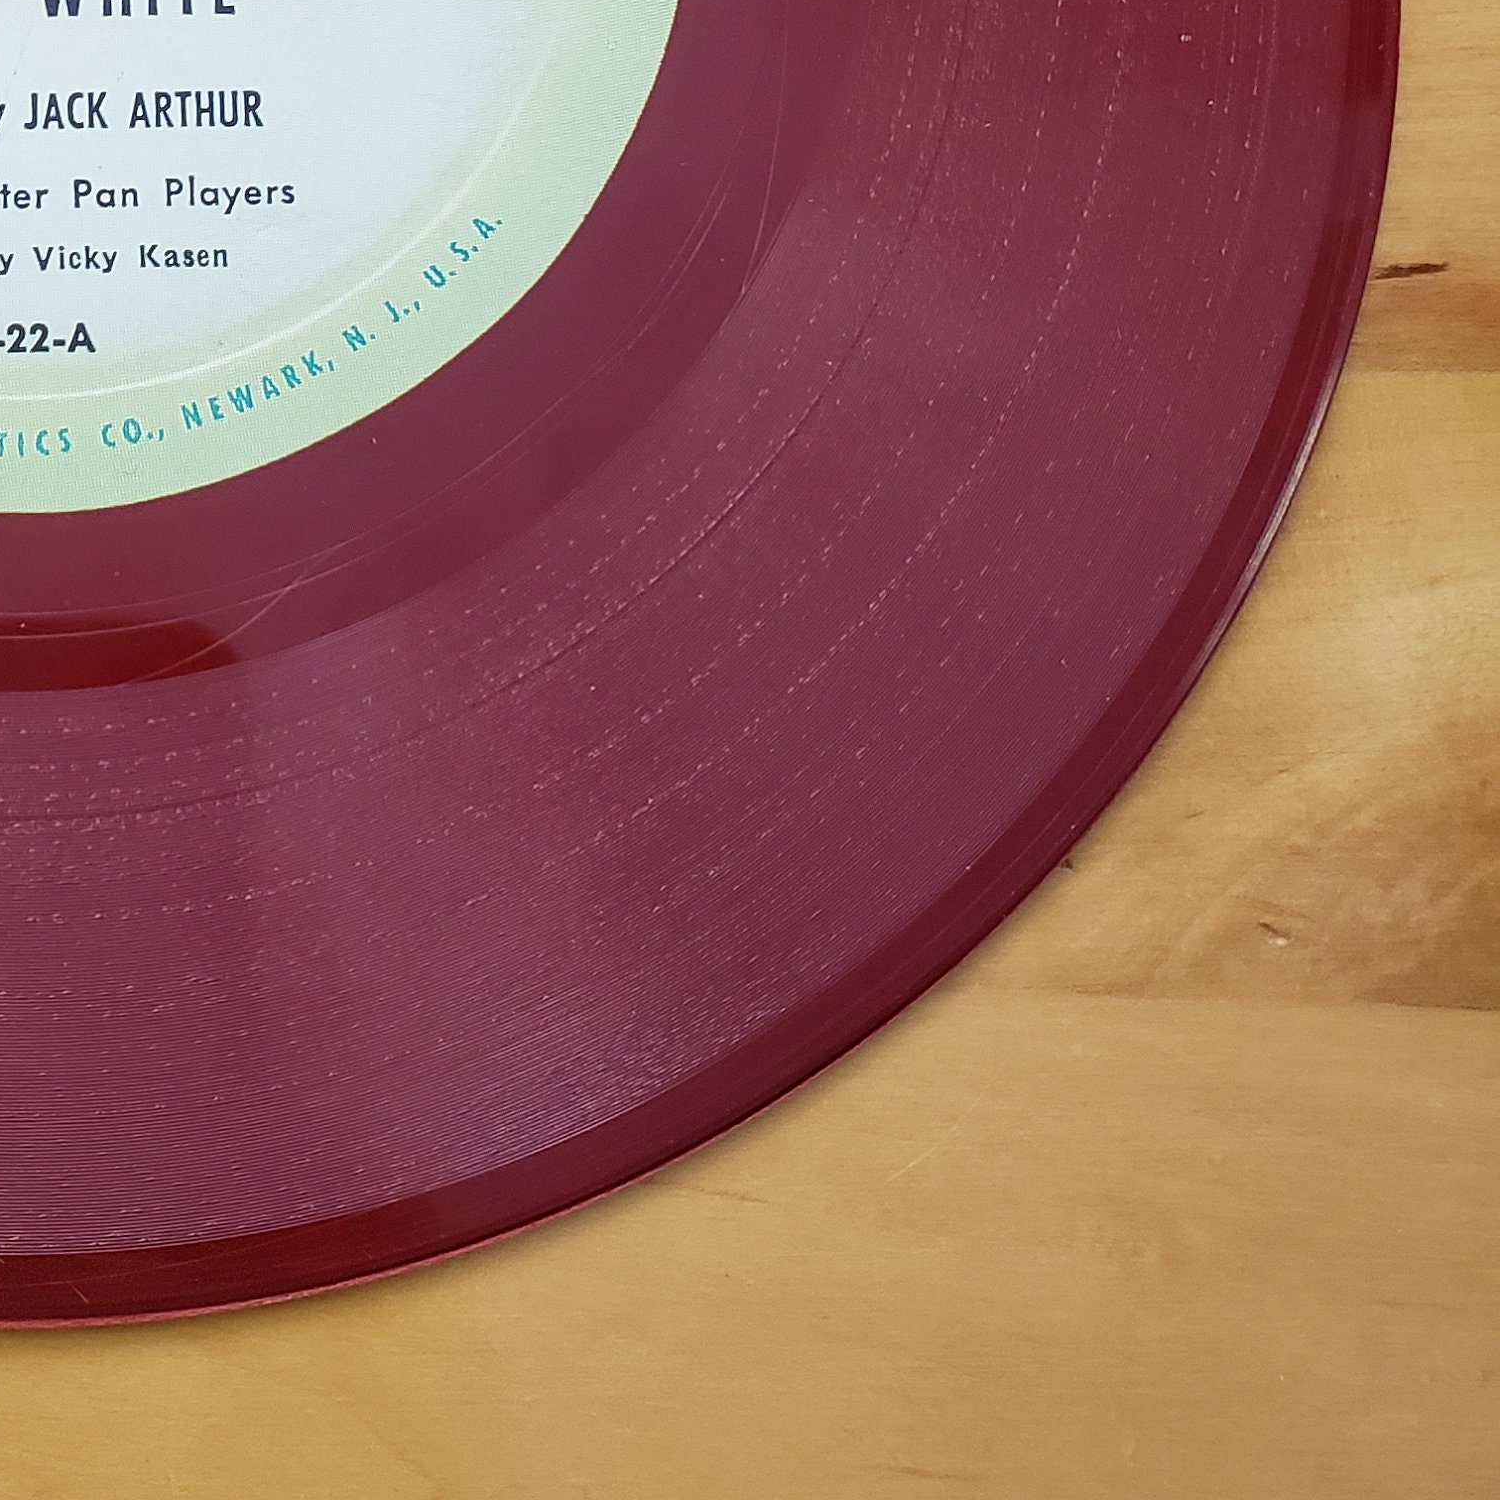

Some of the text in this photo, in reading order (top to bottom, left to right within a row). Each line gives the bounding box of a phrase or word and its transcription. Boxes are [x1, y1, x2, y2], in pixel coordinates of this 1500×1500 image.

[23, 91, 108, 130] JACK
[129, 90, 264, 128] ARTHUR
[73, 179, 139, 208] Pan
[165, 176, 296, 215] Players
[33, 245, 117, 273] Vicky
[139, 244, 229, 268] Kasen
[100, 417, 165, 448] CO.,
[180, 350, 336, 431] NEWARK,
